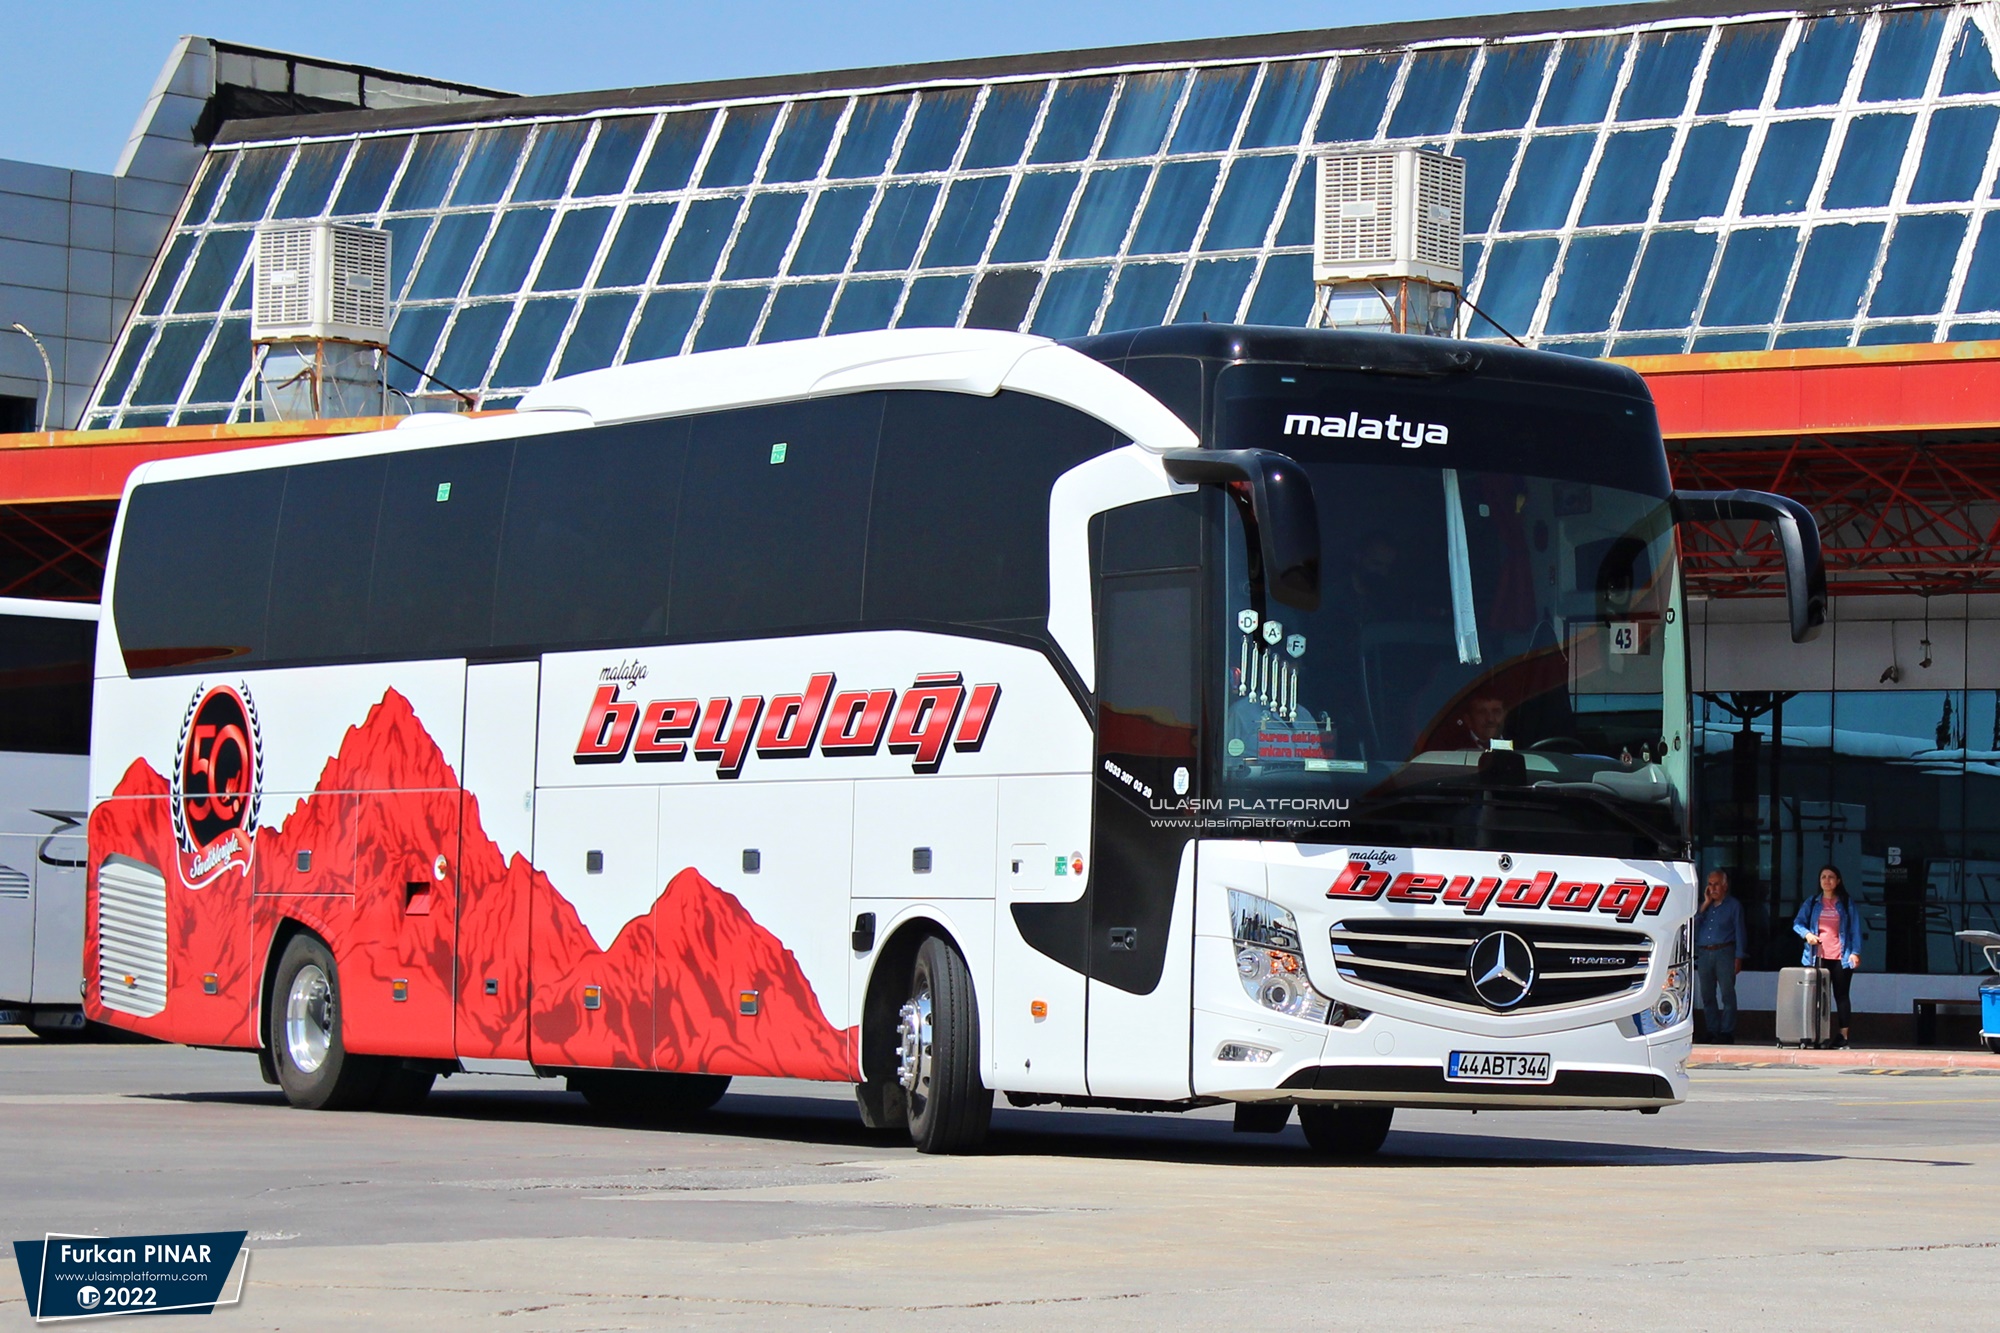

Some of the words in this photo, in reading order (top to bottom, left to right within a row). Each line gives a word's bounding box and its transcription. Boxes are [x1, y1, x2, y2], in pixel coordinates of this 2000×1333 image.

[1283, 411, 1449, 449] malatya
[1615, 628, 1632, 649] 43
[599, 658, 649, 690] malatya
[1104, 759, 1122, 778] 0533
[1348, 849, 1398, 866] malatya
[1569, 956, 1626, 965] TRAVEGO
[1459, 1054, 1547, 1076] 44ABT344
